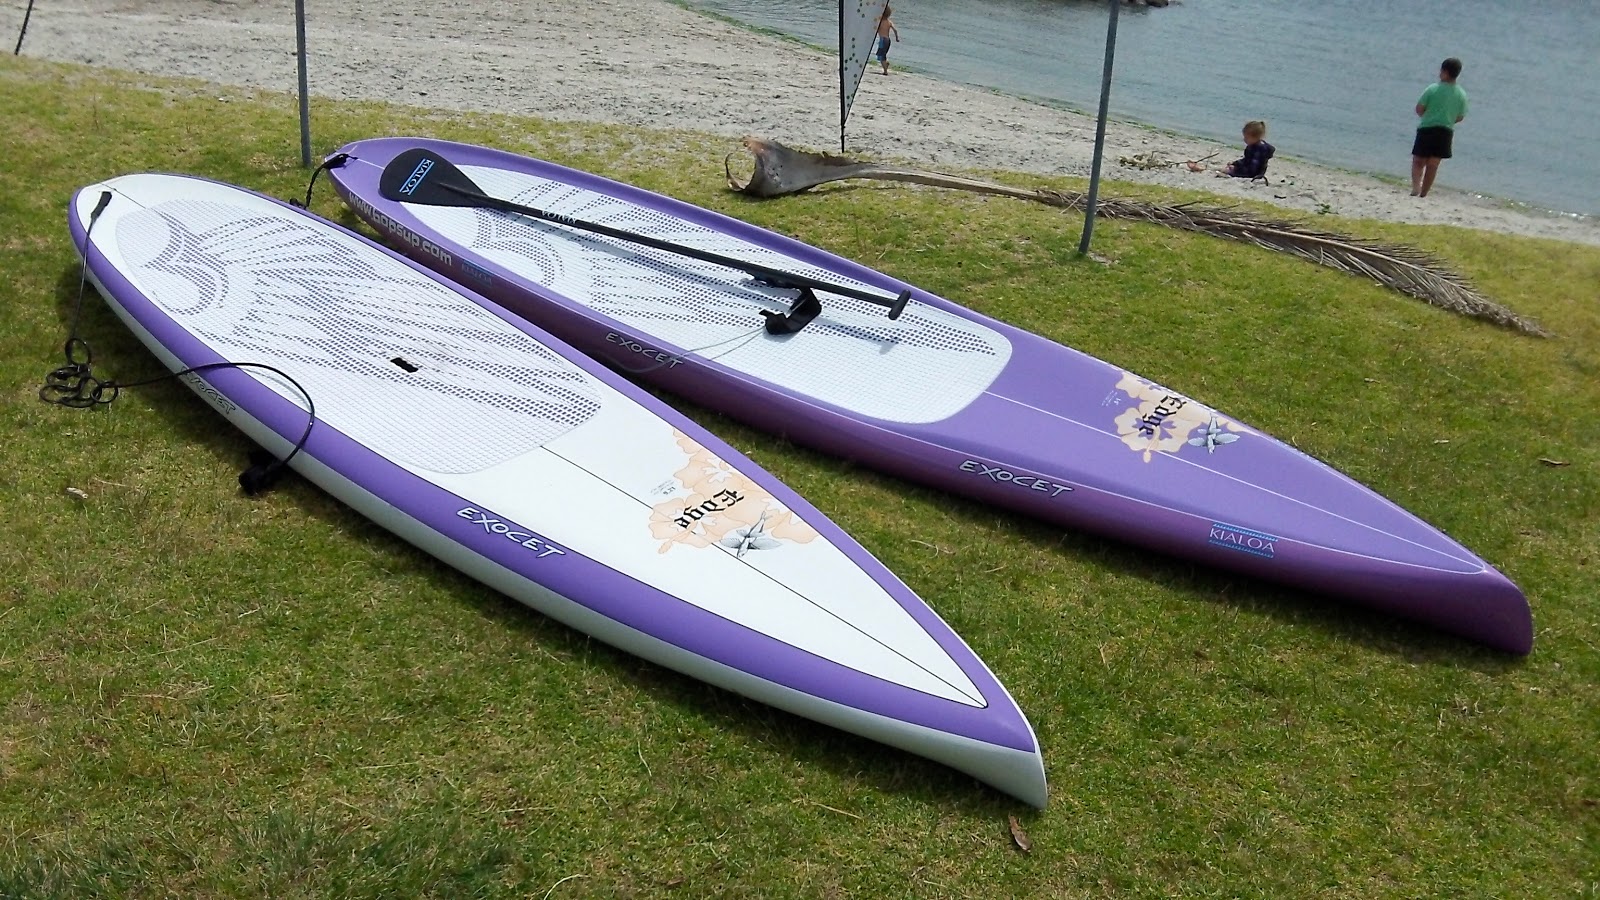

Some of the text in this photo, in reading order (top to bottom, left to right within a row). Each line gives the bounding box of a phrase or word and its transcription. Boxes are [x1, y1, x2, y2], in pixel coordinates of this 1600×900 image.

[402, 160, 432, 193] KIALOA
[605, 332, 685, 369] EXOCET
[1139, 395, 1187, 436] Edge
[959, 460, 1075, 498] EXOCET
[673, 488, 745, 531] Edge
[456, 506, 567, 561] EXOCET
[1209, 527, 1276, 554] KIALOA
